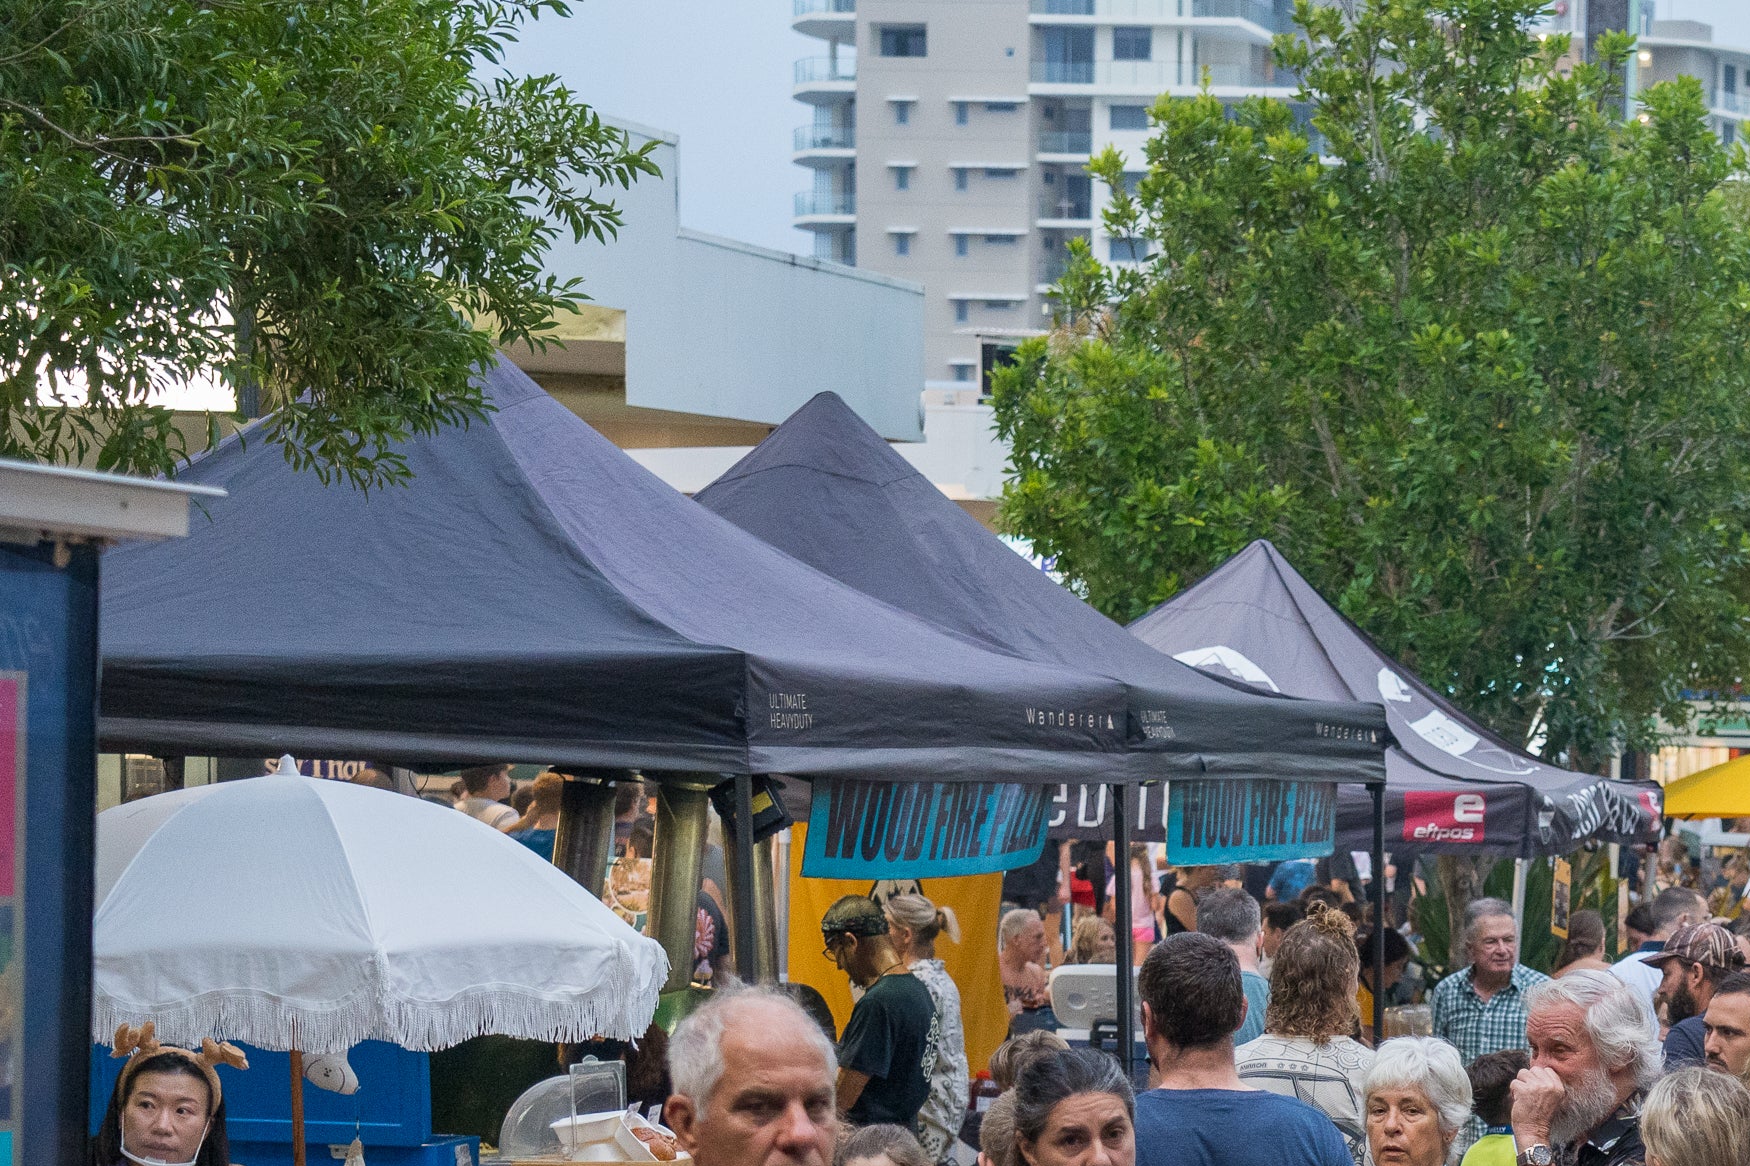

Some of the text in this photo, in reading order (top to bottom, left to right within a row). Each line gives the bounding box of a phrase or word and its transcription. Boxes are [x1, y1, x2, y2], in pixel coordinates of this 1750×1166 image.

[769, 693, 807, 709] ULTIMATE
[770, 712, 813, 729] HEAVYDUTY
[1026, 707, 1103, 728] Wanderer
[824, 780, 928, 863] WOOD
[928, 780, 990, 861] FIRE
[986, 780, 1049, 856] PIZZA
[1182, 781, 1247, 848] WOOD
[1248, 781, 1289, 846] FIRE
[1291, 781, 1333, 843] PIZZA
[1413, 823, 1474, 839] eftpos
